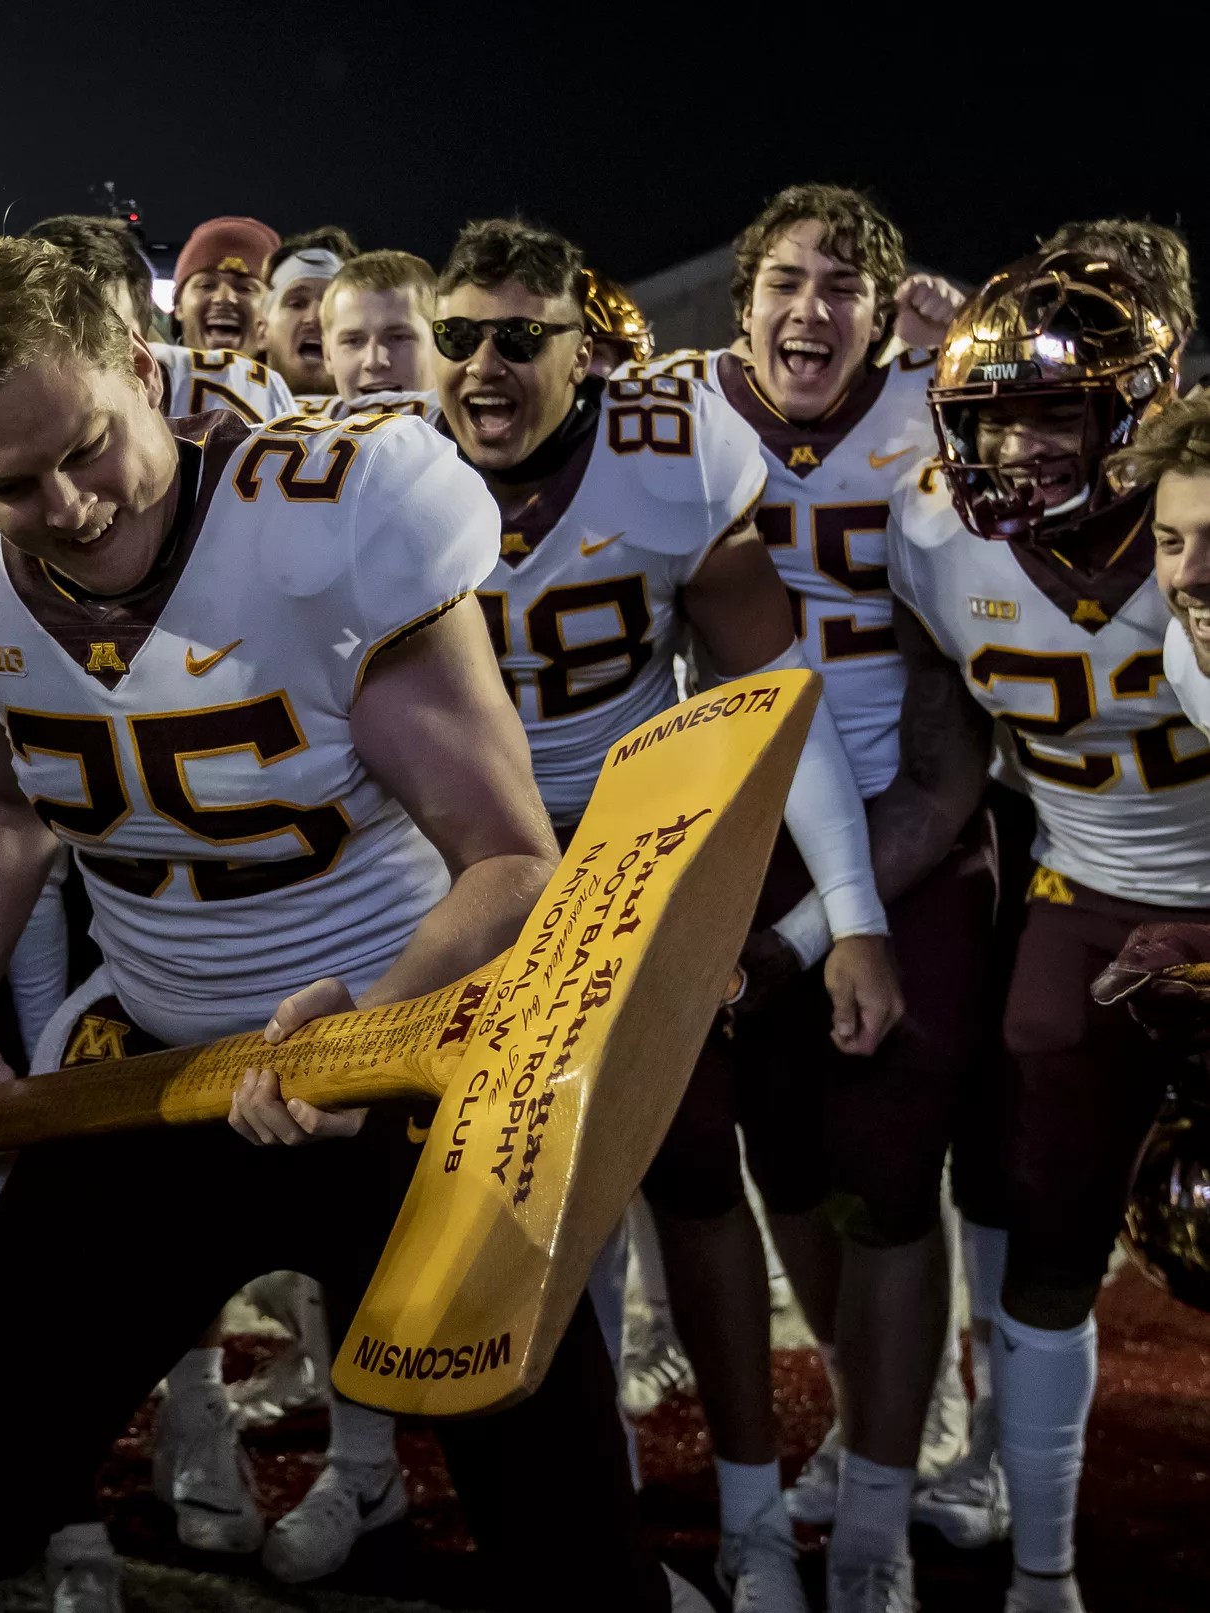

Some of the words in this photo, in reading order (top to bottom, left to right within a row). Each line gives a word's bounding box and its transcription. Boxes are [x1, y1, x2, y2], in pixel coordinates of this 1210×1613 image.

[983, 363, 1018, 381] ROW
[86, 642, 130, 673] M
[612, 687, 781, 767] MINNESOTA
[5, 688, 355, 902] 25
[509, 841, 607, 1002] NATIONAL
[546, 832, 653, 1021] FOOTBALL
[612, 808, 712, 941] Paul
[543, 874, 601, 988] Presented
[437, 981, 492, 1048] M
[479, 980, 512, 1036] 1948
[489, 1013, 516, 1051] W
[444, 1070, 488, 1174] CLUB
[491, 1024, 558, 1185] TROPHY
[513, 957, 622, 1208] Bunyan
[352, 1332, 511, 1381] WISCONSIN
